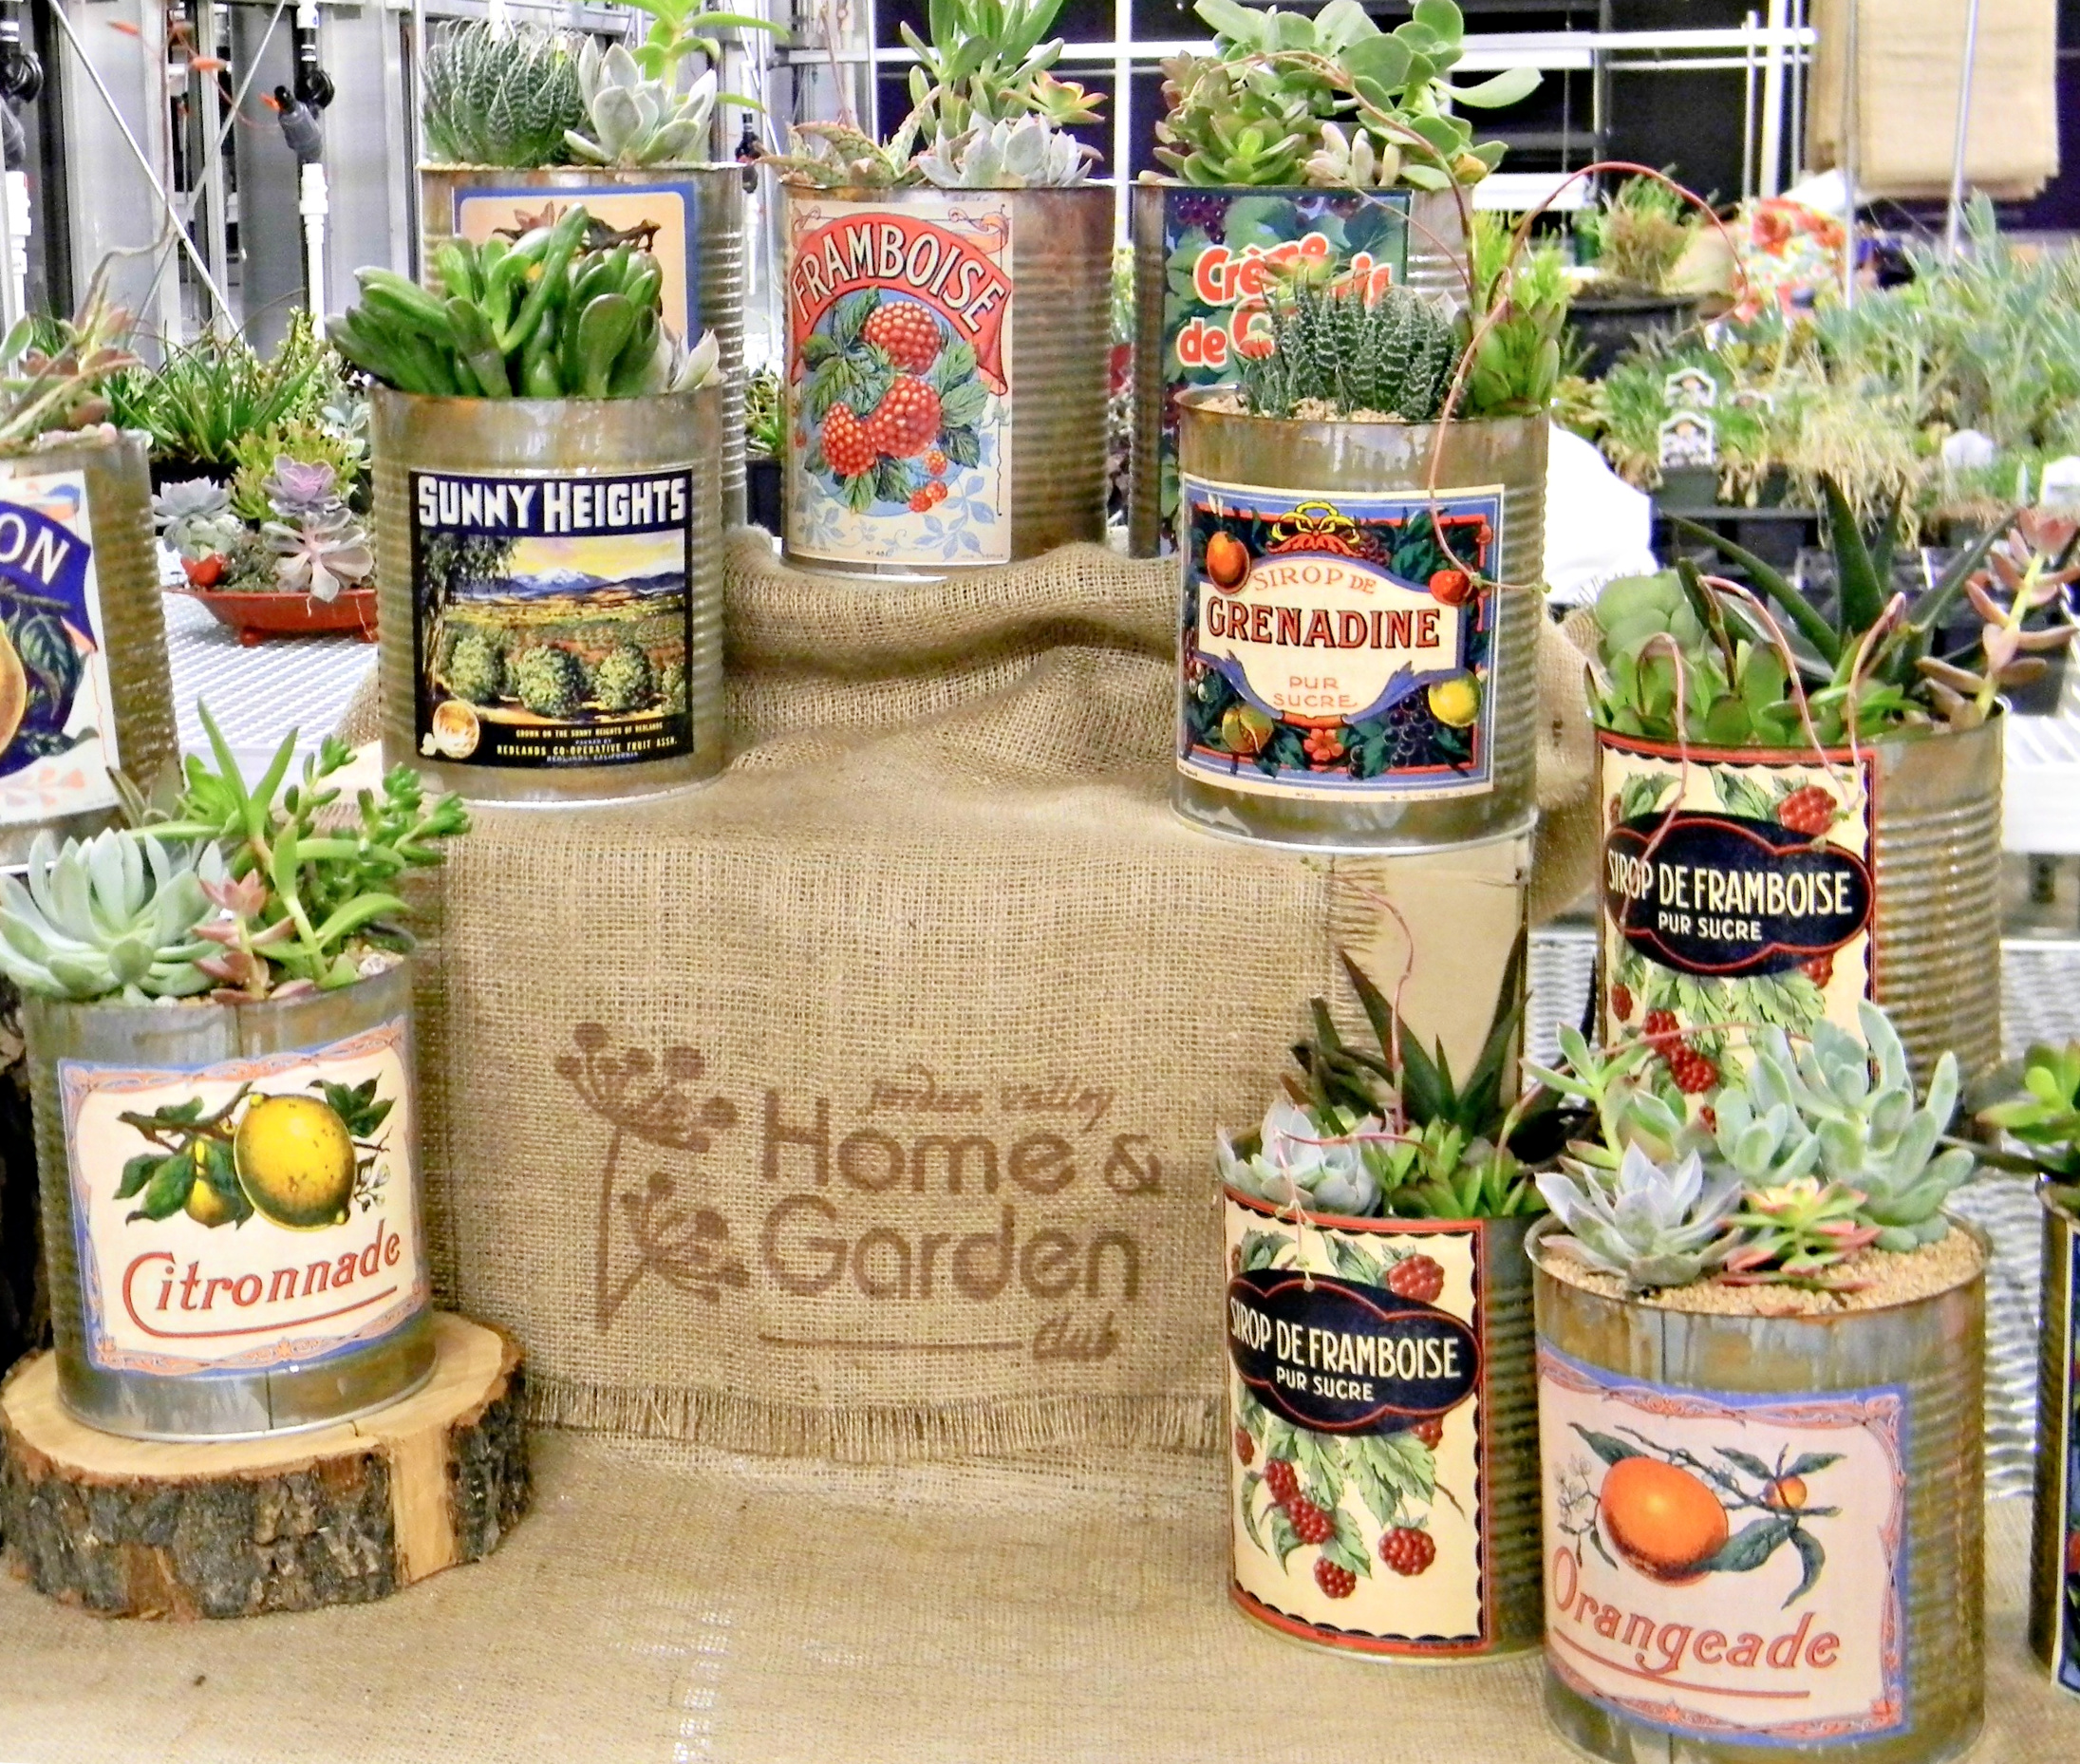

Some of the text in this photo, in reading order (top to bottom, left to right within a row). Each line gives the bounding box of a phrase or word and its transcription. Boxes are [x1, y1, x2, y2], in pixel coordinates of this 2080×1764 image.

[792, 222, 1005, 333] FRAMBOISE
[1177, 316, 1227, 368] de
[418, 476, 685, 533] SUNNY HEIGHTS
[1253, 564, 1377, 594] SIROP DE
[1206, 595, 1441, 650] GRENADINE
[1273, 692, 1358, 708] SUCRE
[1289, 676, 1339, 690] PUR
[497, 744, 547, 757] REDLANDS
[627, 740, 651, 752] FRUIT
[1607, 848, 1853, 917] SIROP DE FRAMBOISE
[1658, 912, 1763, 942] PUR SUCRE
[763, 1089, 1162, 1196] Home &
[764, 1193, 1139, 1302] Garden
[122, 1217, 402, 1338] Citronnade
[1230, 1297, 1463, 1381] SIROP DE FRAMBOISE
[1276, 1365, 1376, 1402] PUR SUCRE
[1552, 1546, 1841, 1677] Orangeade
